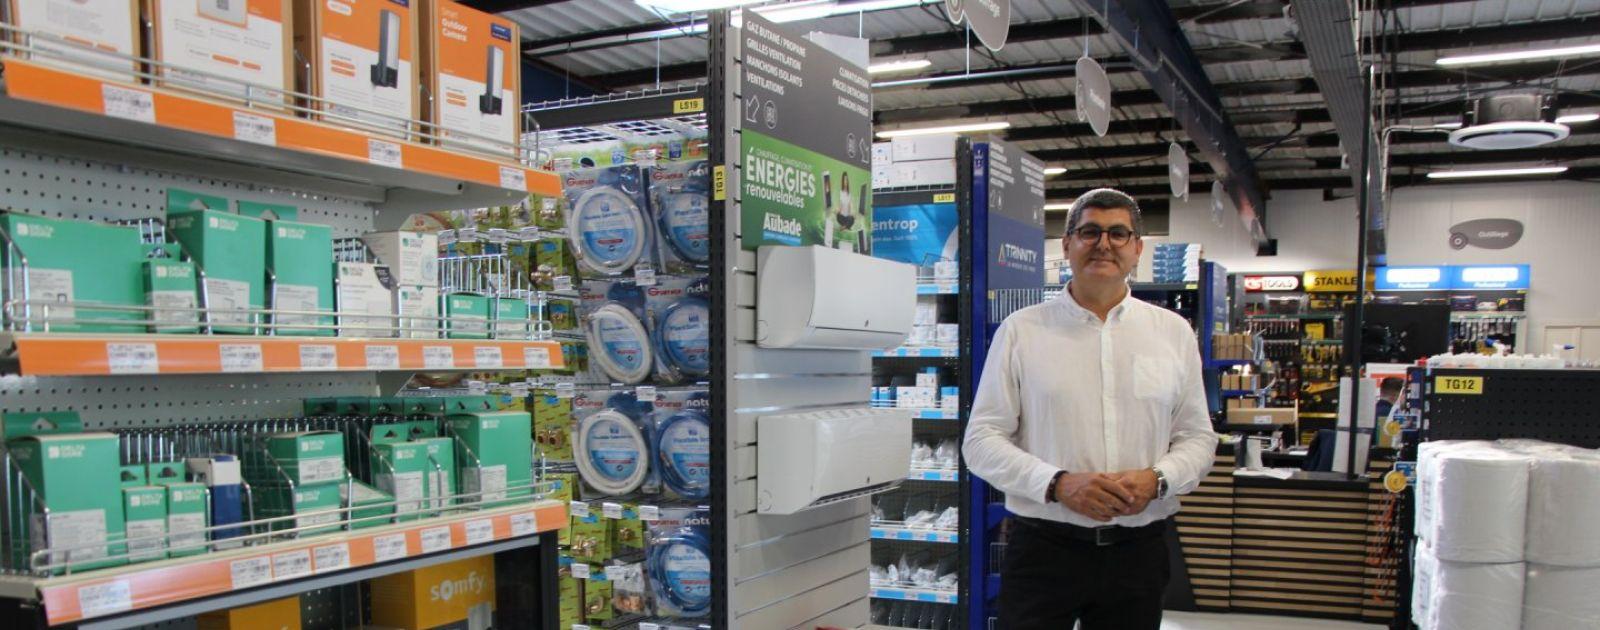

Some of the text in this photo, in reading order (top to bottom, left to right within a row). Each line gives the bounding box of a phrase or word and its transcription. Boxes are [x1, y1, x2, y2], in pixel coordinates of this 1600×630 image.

[442, 27, 467, 42] Camera
[746, 21, 759, 34] GAZ
[759, 26, 780, 46] BUTANE
[783, 37, 806, 58] PROPANE
[746, 38, 802, 72] GRILLES VENTILATION
[746, 54, 803, 88] MANCHONS ISOLANTS
[746, 69, 785, 96] VENTILATIONS
[679, 100, 698, 110] LS19
[745, 146, 816, 198] ÉNERGIES
[745, 183, 805, 209] renouvelables
[763, 212, 802, 237] Aubade
[872, 219, 919, 233] entrop
[1314, 276, 1357, 286] STANLE
[1446, 379, 1475, 390] TG12
[686, 399, 709, 407] natu
[685, 517, 710, 526] natu
[430, 571, 485, 602] somfy
